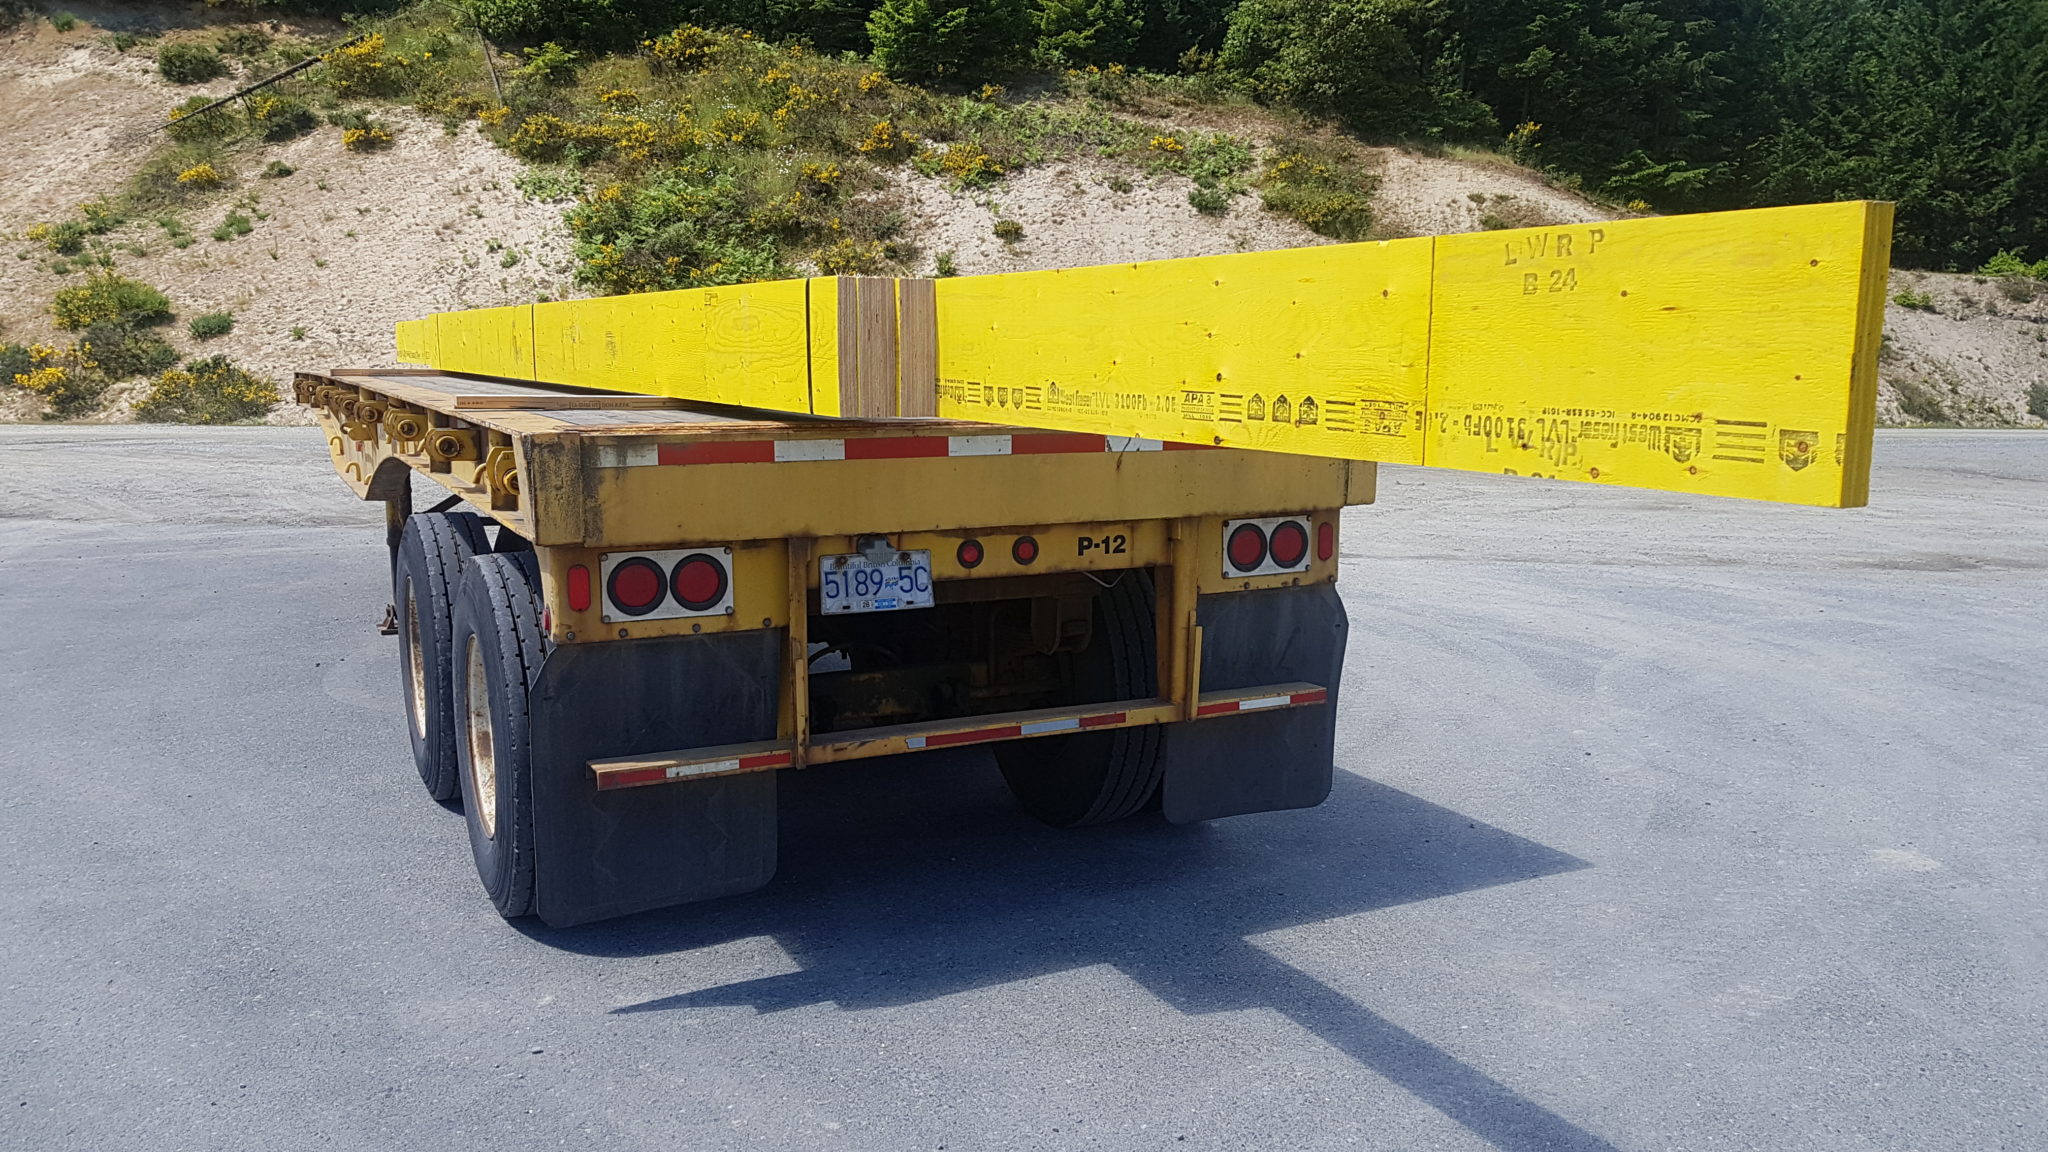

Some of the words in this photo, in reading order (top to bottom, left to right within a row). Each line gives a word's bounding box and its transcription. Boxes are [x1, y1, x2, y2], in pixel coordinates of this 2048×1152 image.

[1549, 268, 1578, 293] 24
[1115, 392, 1147, 411] 3100Fb
[1184, 393, 1204, 405] APA
[1078, 534, 1126, 556] P-12
[824, 569, 883, 599] 5189
[898, 565, 929, 593] 5C
